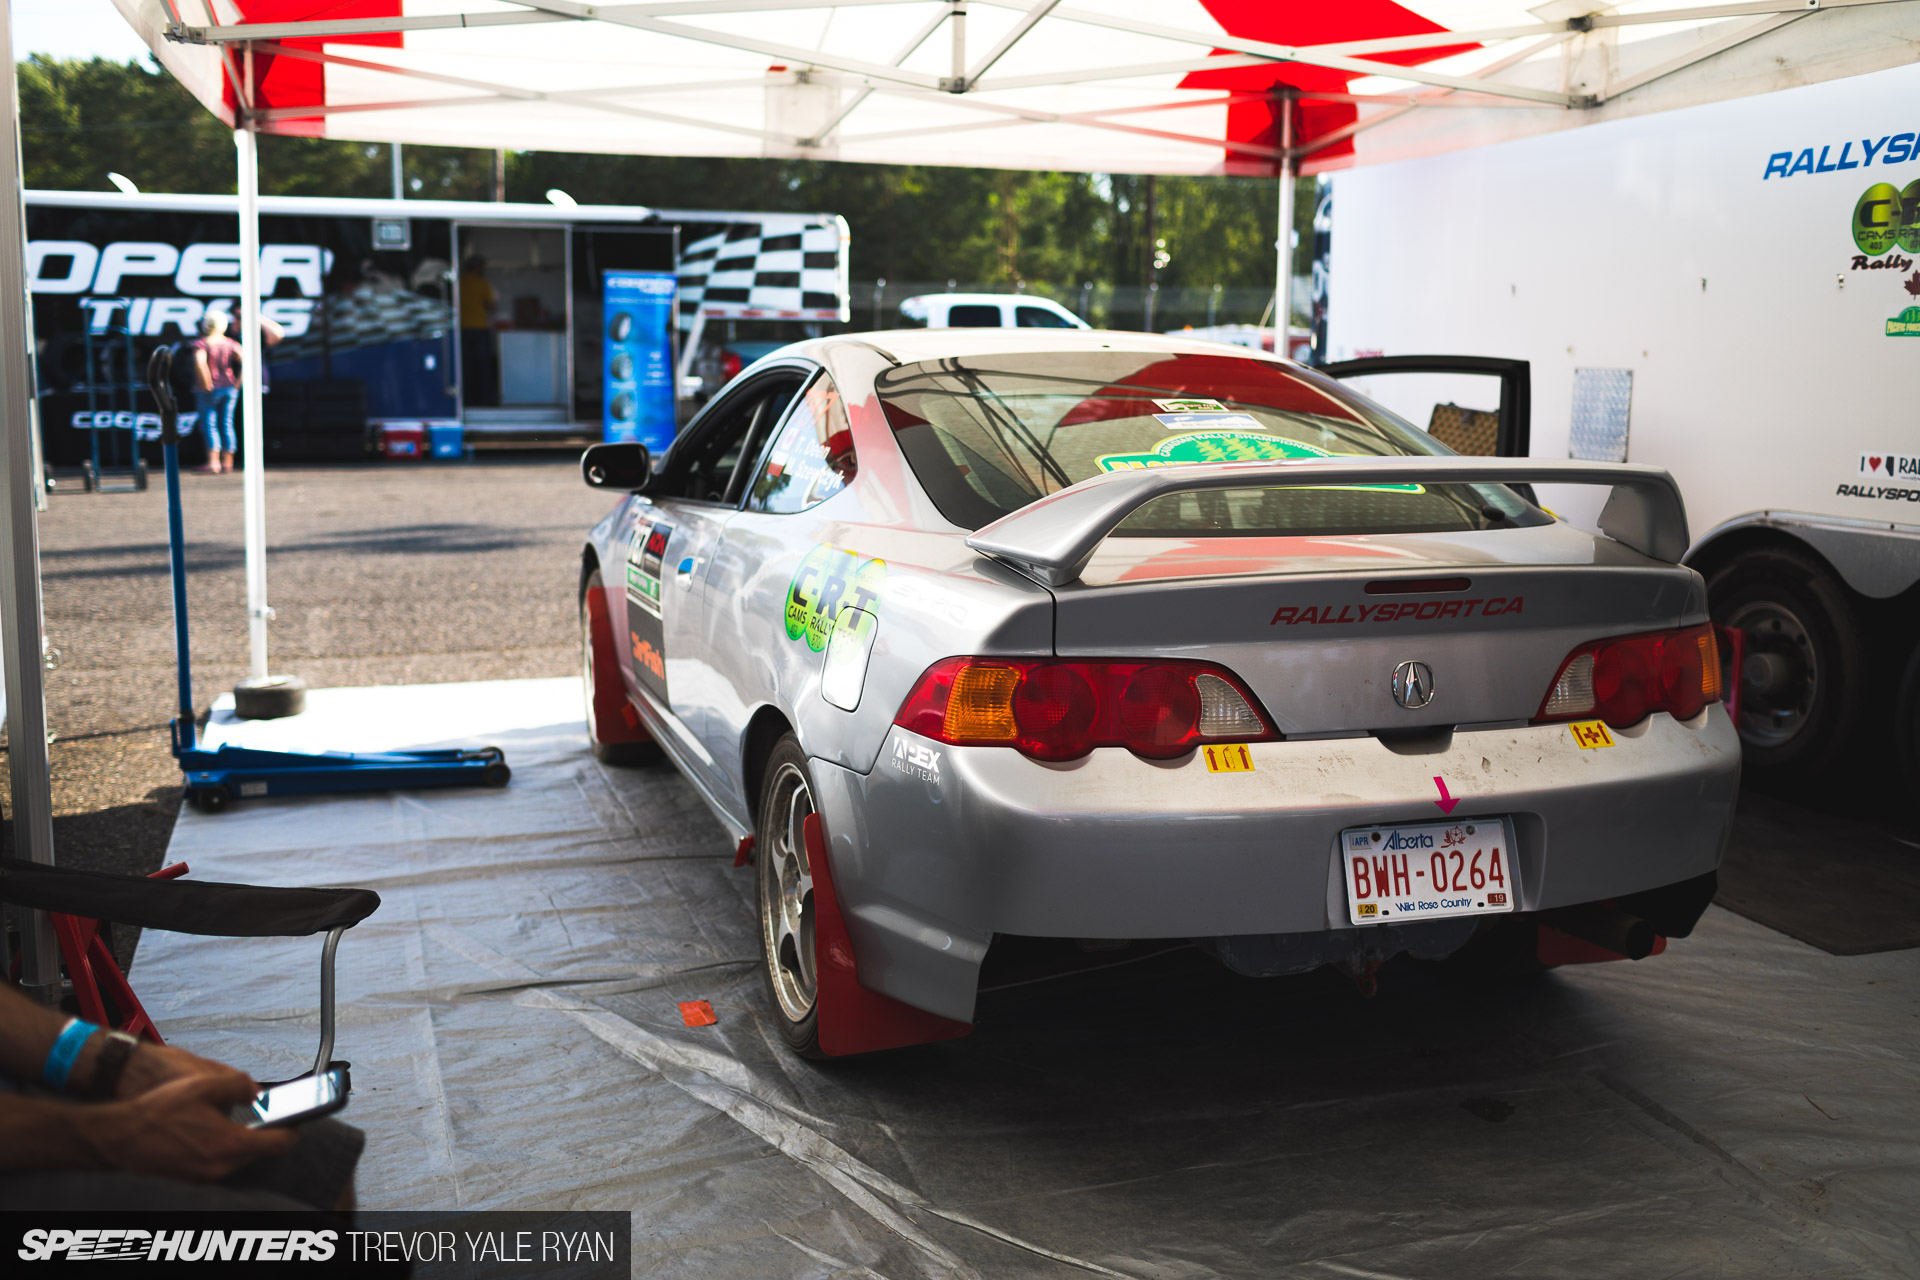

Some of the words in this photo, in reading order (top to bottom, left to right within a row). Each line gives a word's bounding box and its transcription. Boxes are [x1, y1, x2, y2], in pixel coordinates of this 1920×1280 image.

[1763, 132, 1920, 180] RALLYS
[1858, 229, 1896, 241] CAMS
[1851, 254, 1914, 273] Rally
[78, 297, 316, 338] TIRS
[1160, 435, 1196, 457] CANADIAN
[1194, 432, 1231, 441] RALLY
[1860, 456, 1865, 472] I
[787, 605, 808, 625] CAMS
[809, 616, 833, 636] RALLY
[891, 757, 915, 776] RALLY
[917, 767, 940, 786] TEAM
[1355, 836, 1369, 846] APR
[1382, 830, 1434, 851] Alberta
[1352, 847, 1505, 900] BWH-0264
[1364, 904, 1376, 914] 20
[1395, 901, 1416, 912] Wild
[1418, 900, 1439, 911] Rose
[1440, 897, 1472, 909] Country
[1493, 894, 1504, 902] 19
